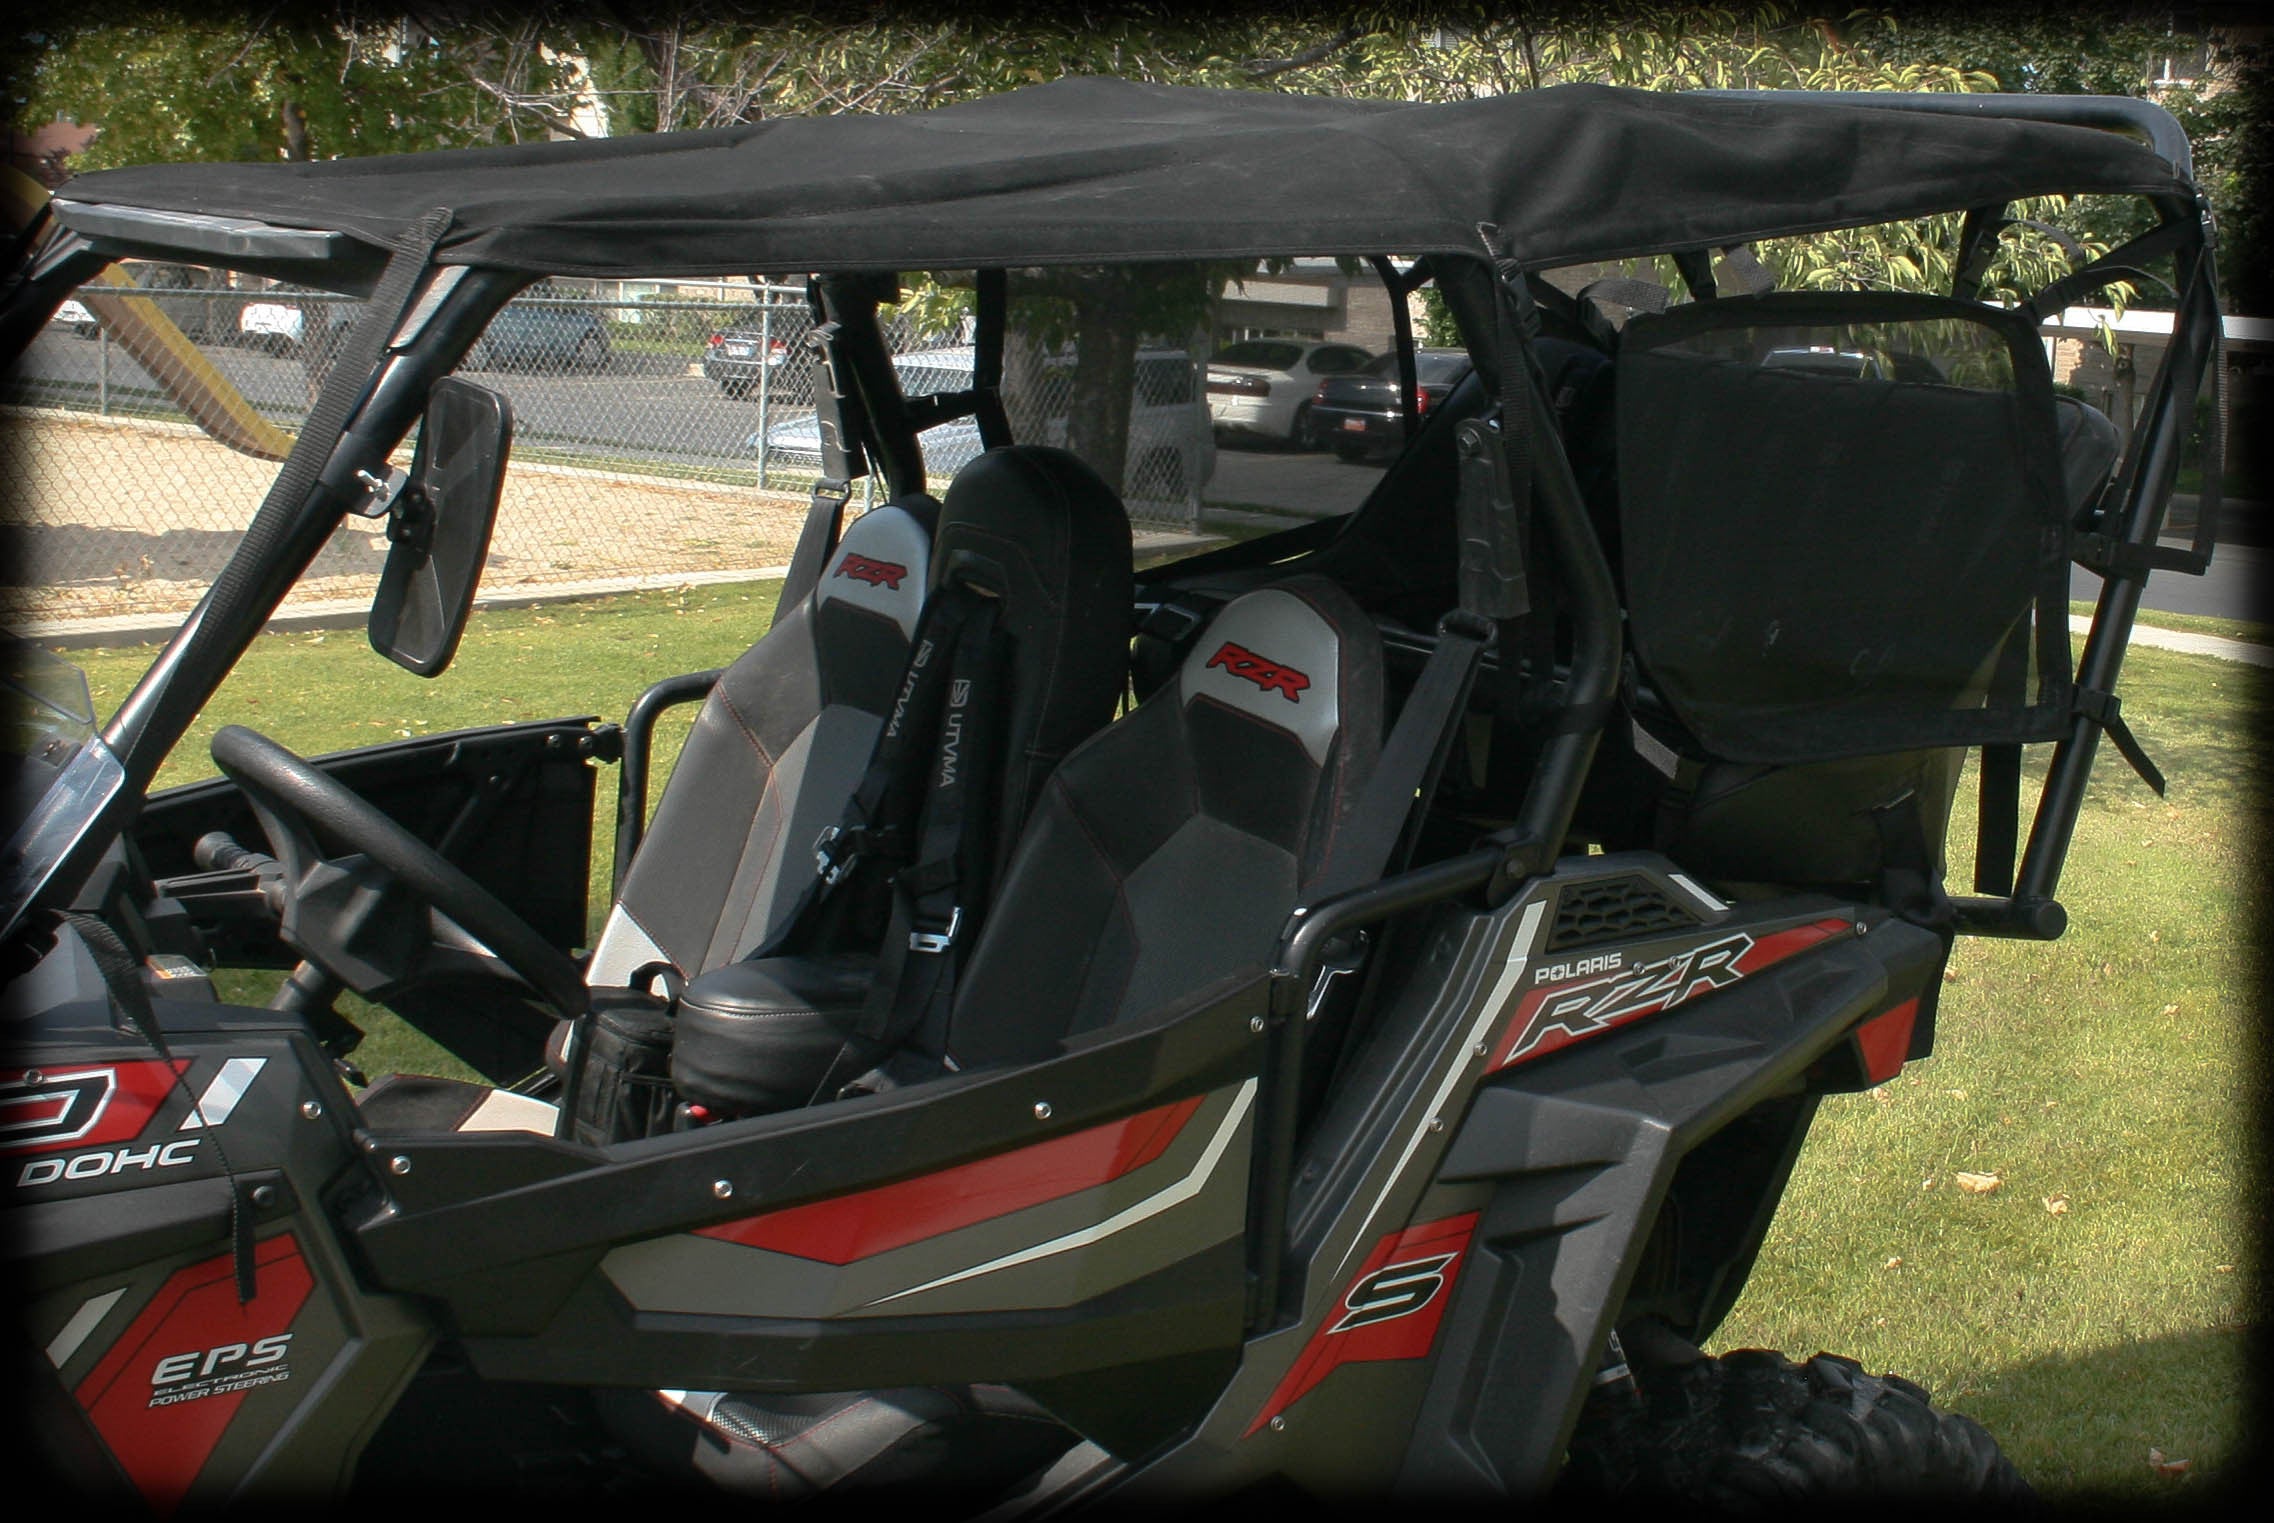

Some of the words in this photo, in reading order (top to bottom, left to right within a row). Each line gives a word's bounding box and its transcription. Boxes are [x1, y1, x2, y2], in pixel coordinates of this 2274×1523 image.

[833, 552, 908, 591] RZR
[1206, 641, 1310, 704] RZR
[886, 671, 919, 737] UTVMA
[940, 714, 963, 788] UTVMA
[1535, 952, 1622, 984] POLARIS
[1504, 932, 1755, 1064] RZR
[16, 1138, 201, 1187] DOHC
[151, 1333, 294, 1385] EPS
[154, 1364, 288, 1396] ELECTRONIC
[149, 1389, 211, 1408] POWER
[213, 1371, 290, 1395] STEERING
